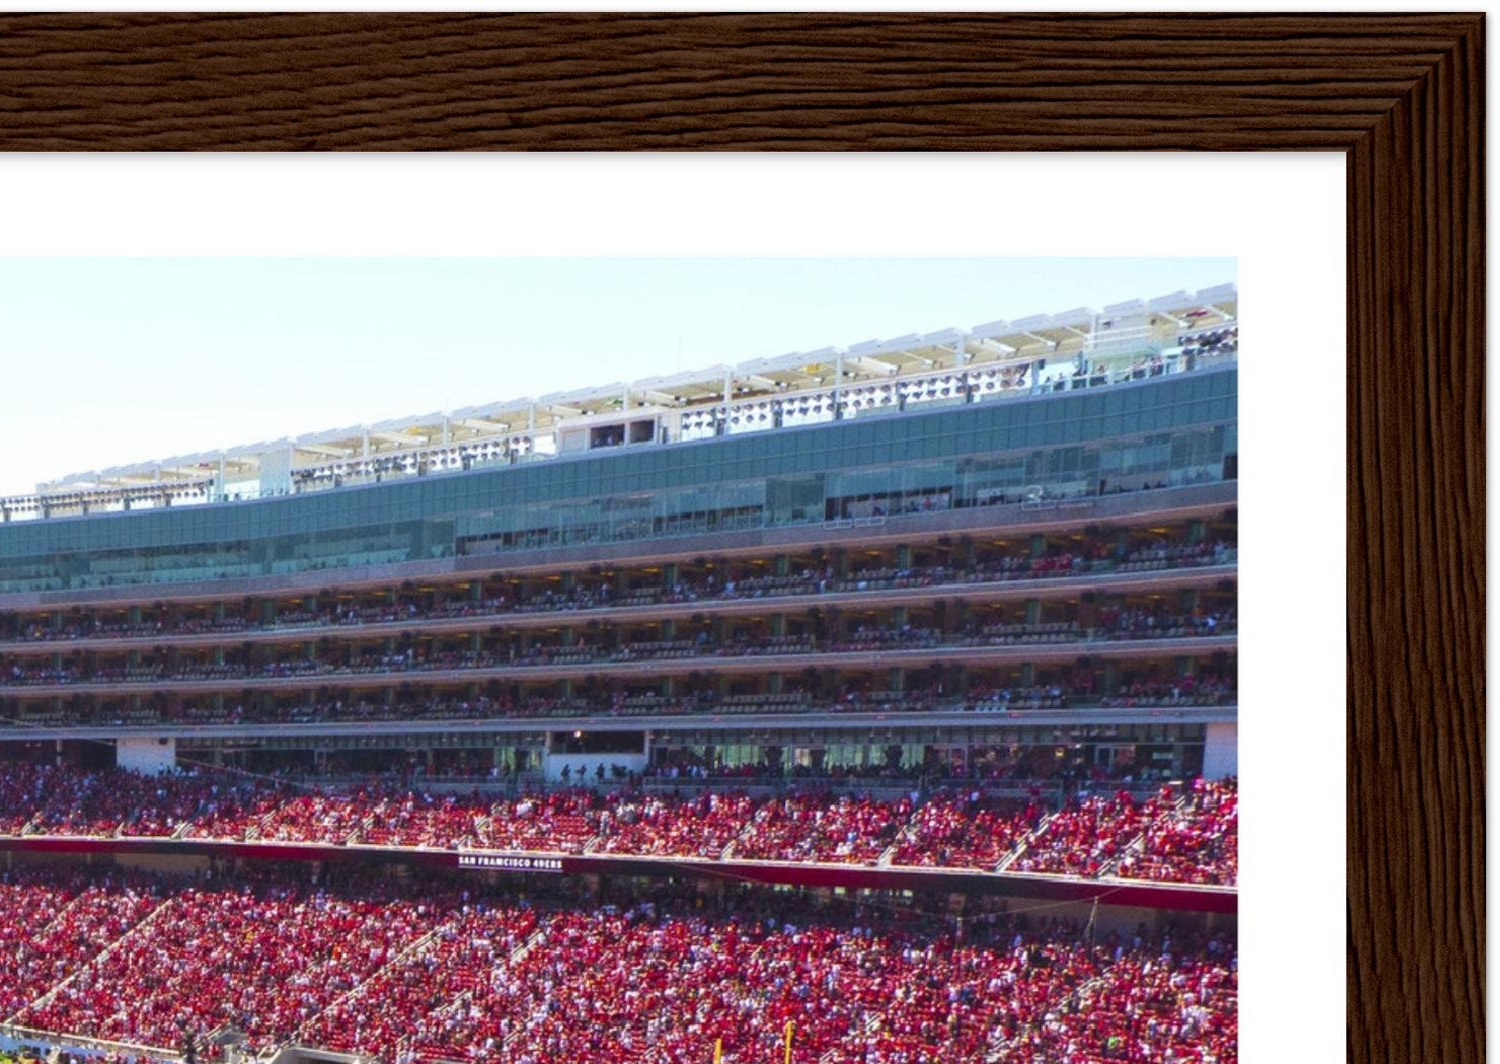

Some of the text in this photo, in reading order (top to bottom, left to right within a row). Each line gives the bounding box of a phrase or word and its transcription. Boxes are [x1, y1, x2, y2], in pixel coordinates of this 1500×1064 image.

[458, 856, 562, 869] SAN FRANCISCO 49ERS
